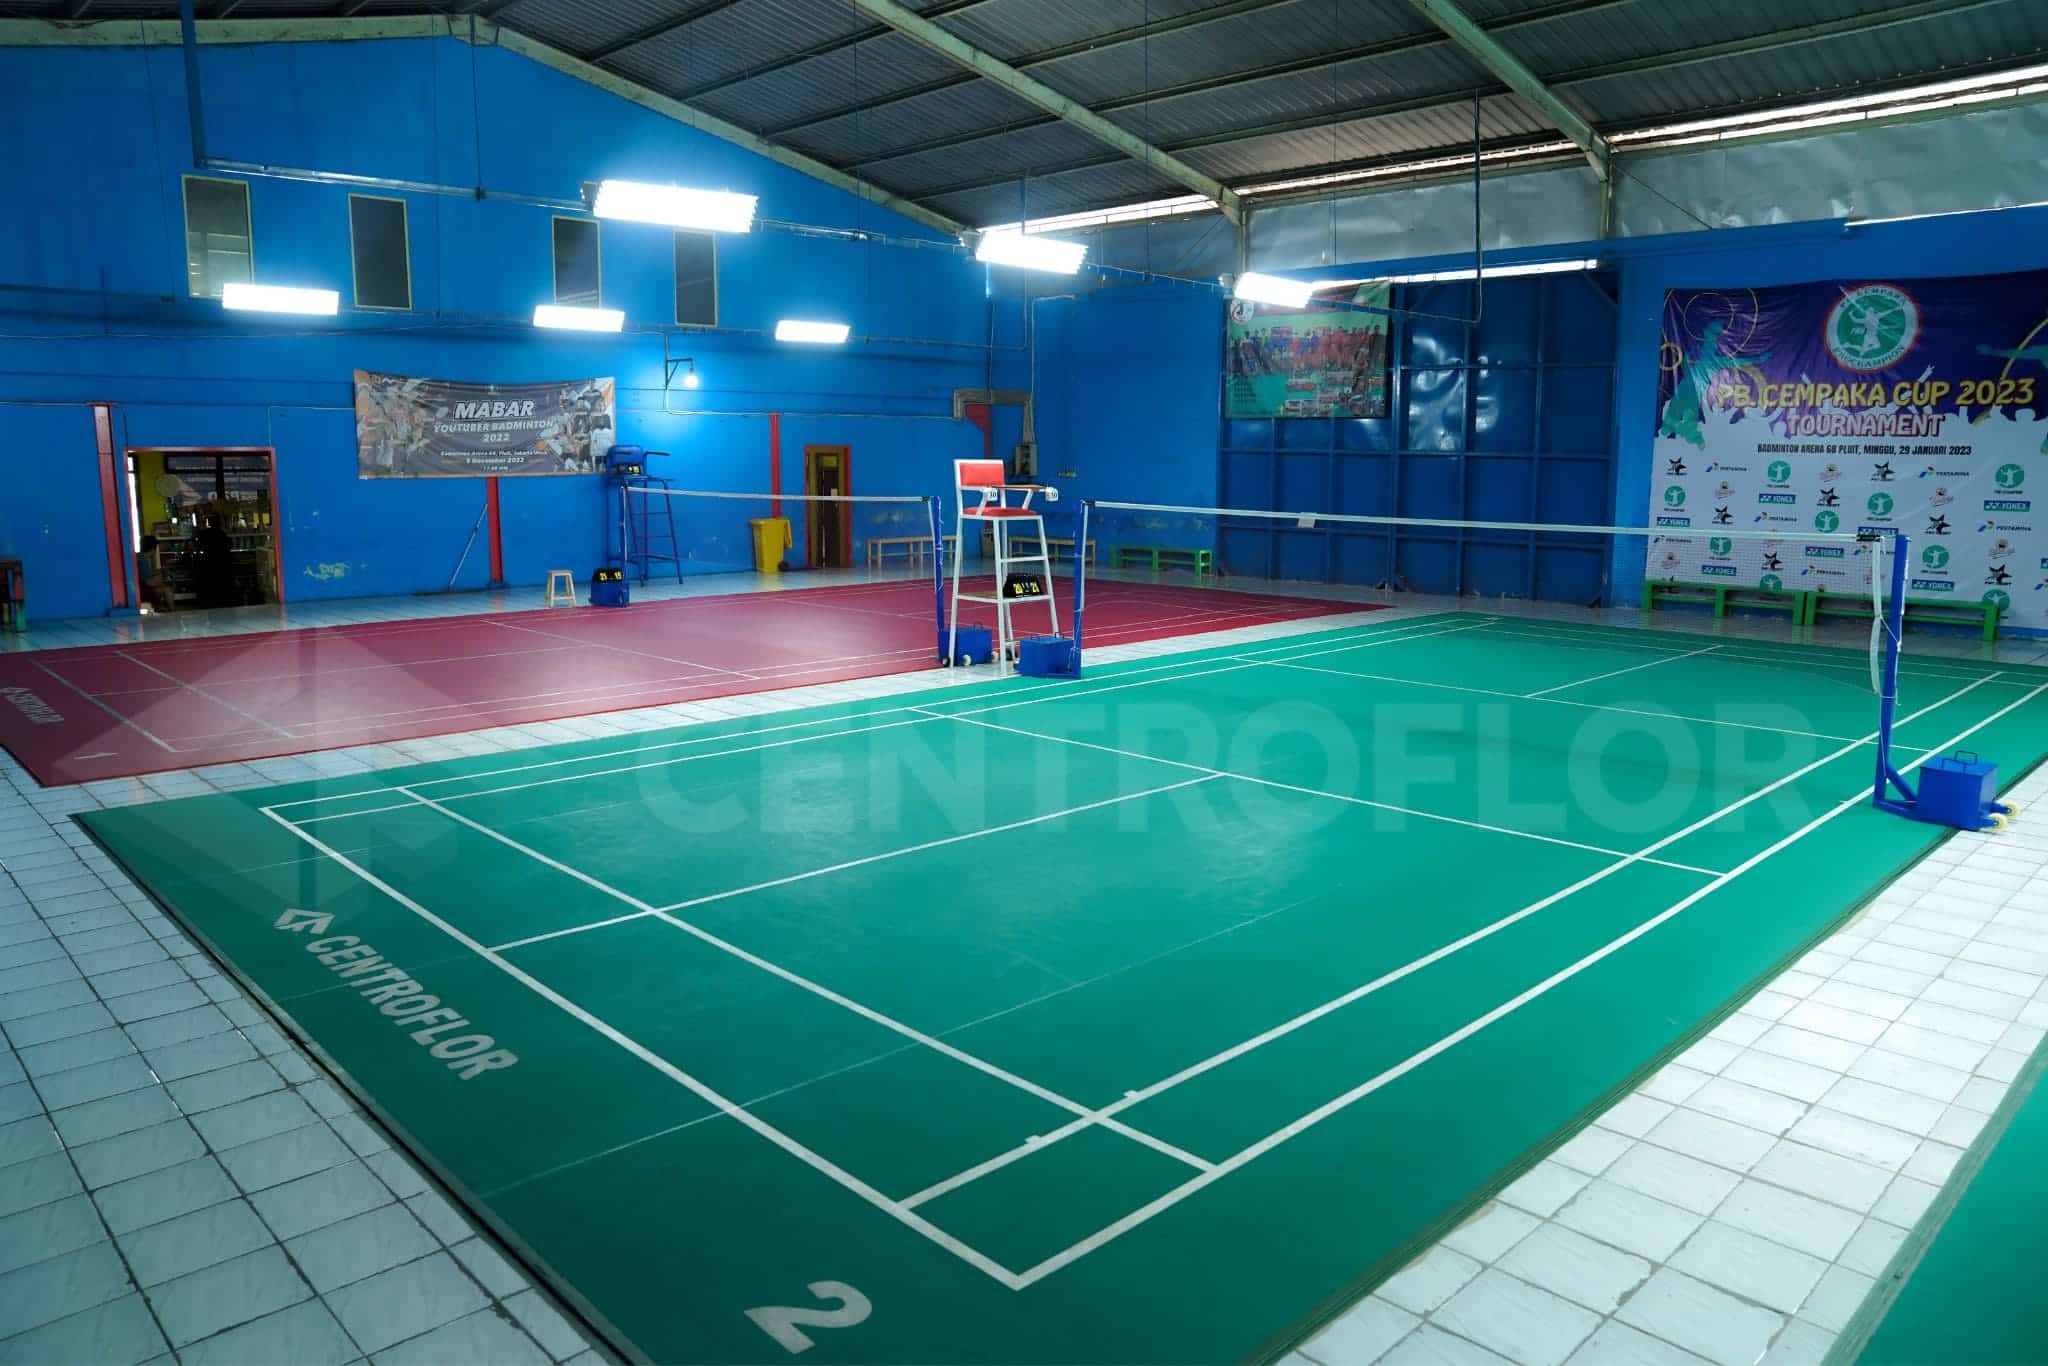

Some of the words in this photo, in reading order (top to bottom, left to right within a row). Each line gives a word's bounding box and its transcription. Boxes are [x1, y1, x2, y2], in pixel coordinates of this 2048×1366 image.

[1761, 381, 1887, 407] CEMPAKA
[1893, 380, 1950, 406] CUP
[1955, 378, 2035, 405] 2023
[454, 400, 535, 419] MABAR
[433, 422, 490, 434] YOUTUBER
[491, 420, 554, 431] BADMINTON
[1787, 413, 1945, 437] TOURNAMENT
[1758, 443, 1800, 453] BADMINTON
[1801, 444, 1825, 453] ARENA
[1898, 445, 1910, 455] 29
[1911, 445, 1948, 456] JANUARI
[1949, 445, 1972, 455] 2023
[305, 935, 519, 1081] CENTROFLOR
[743, 1280, 873, 1354] 2
